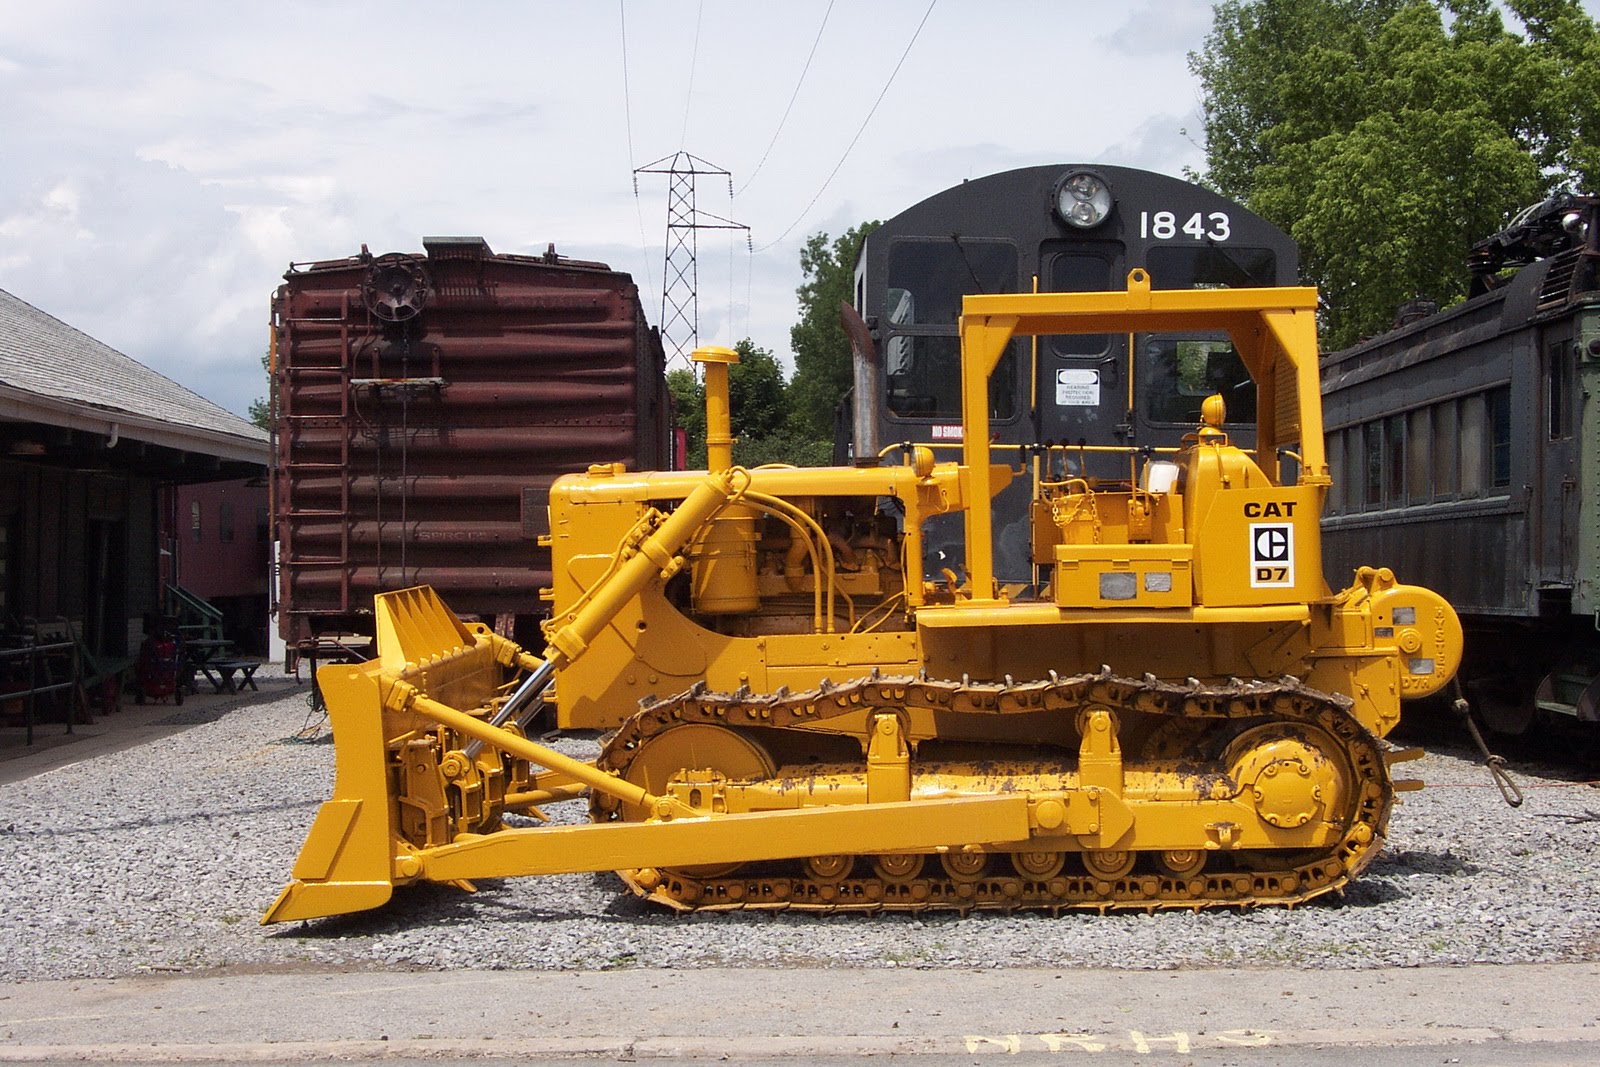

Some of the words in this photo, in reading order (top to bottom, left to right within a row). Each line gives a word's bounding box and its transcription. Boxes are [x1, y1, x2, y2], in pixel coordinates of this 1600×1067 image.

[1140, 211, 1231, 242] 1843
[932, 425, 943, 438] NO
[943, 425, 964, 438] SMOK
[1243, 502, 1297, 518] CAT
[1256, 567, 1288, 581] D7
[1433, 605, 1446, 679] HYSTER
